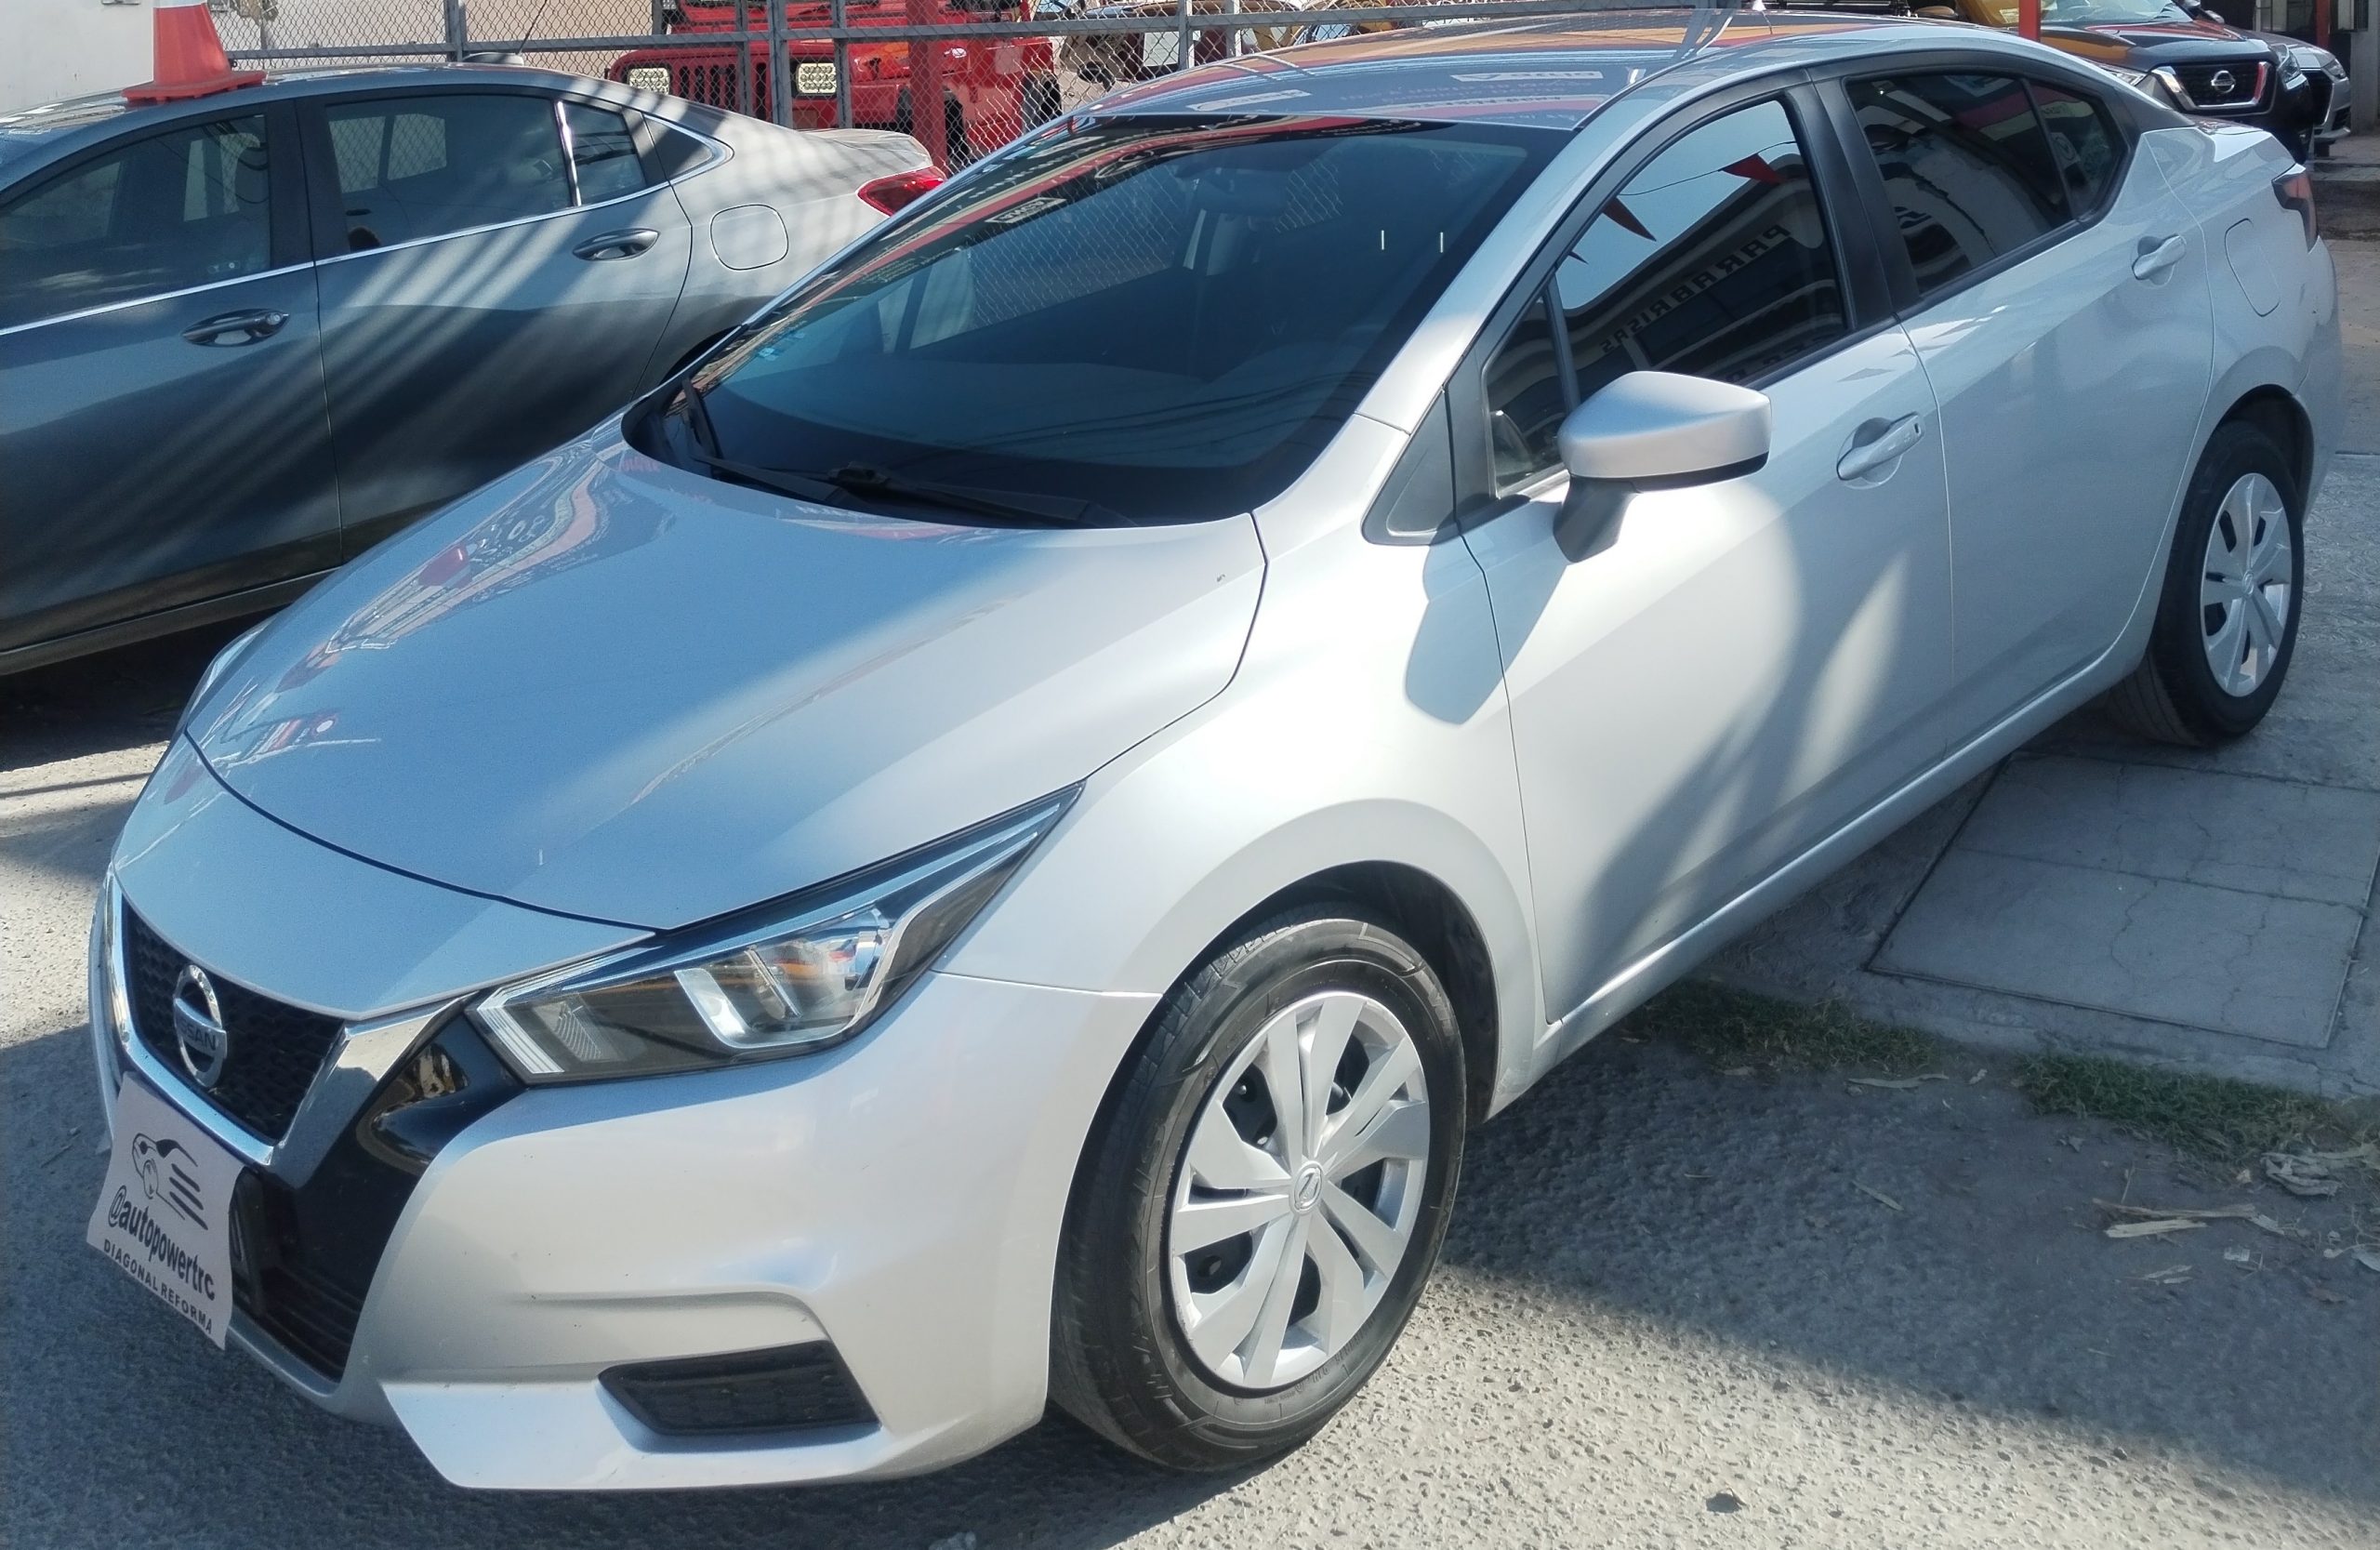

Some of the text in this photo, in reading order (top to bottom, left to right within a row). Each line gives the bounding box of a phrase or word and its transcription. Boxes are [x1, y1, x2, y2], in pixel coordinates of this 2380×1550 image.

[103, 1239, 212, 1334] DIAGONAL REFORMA
[108, 1185, 216, 1302] @autopowertrc
